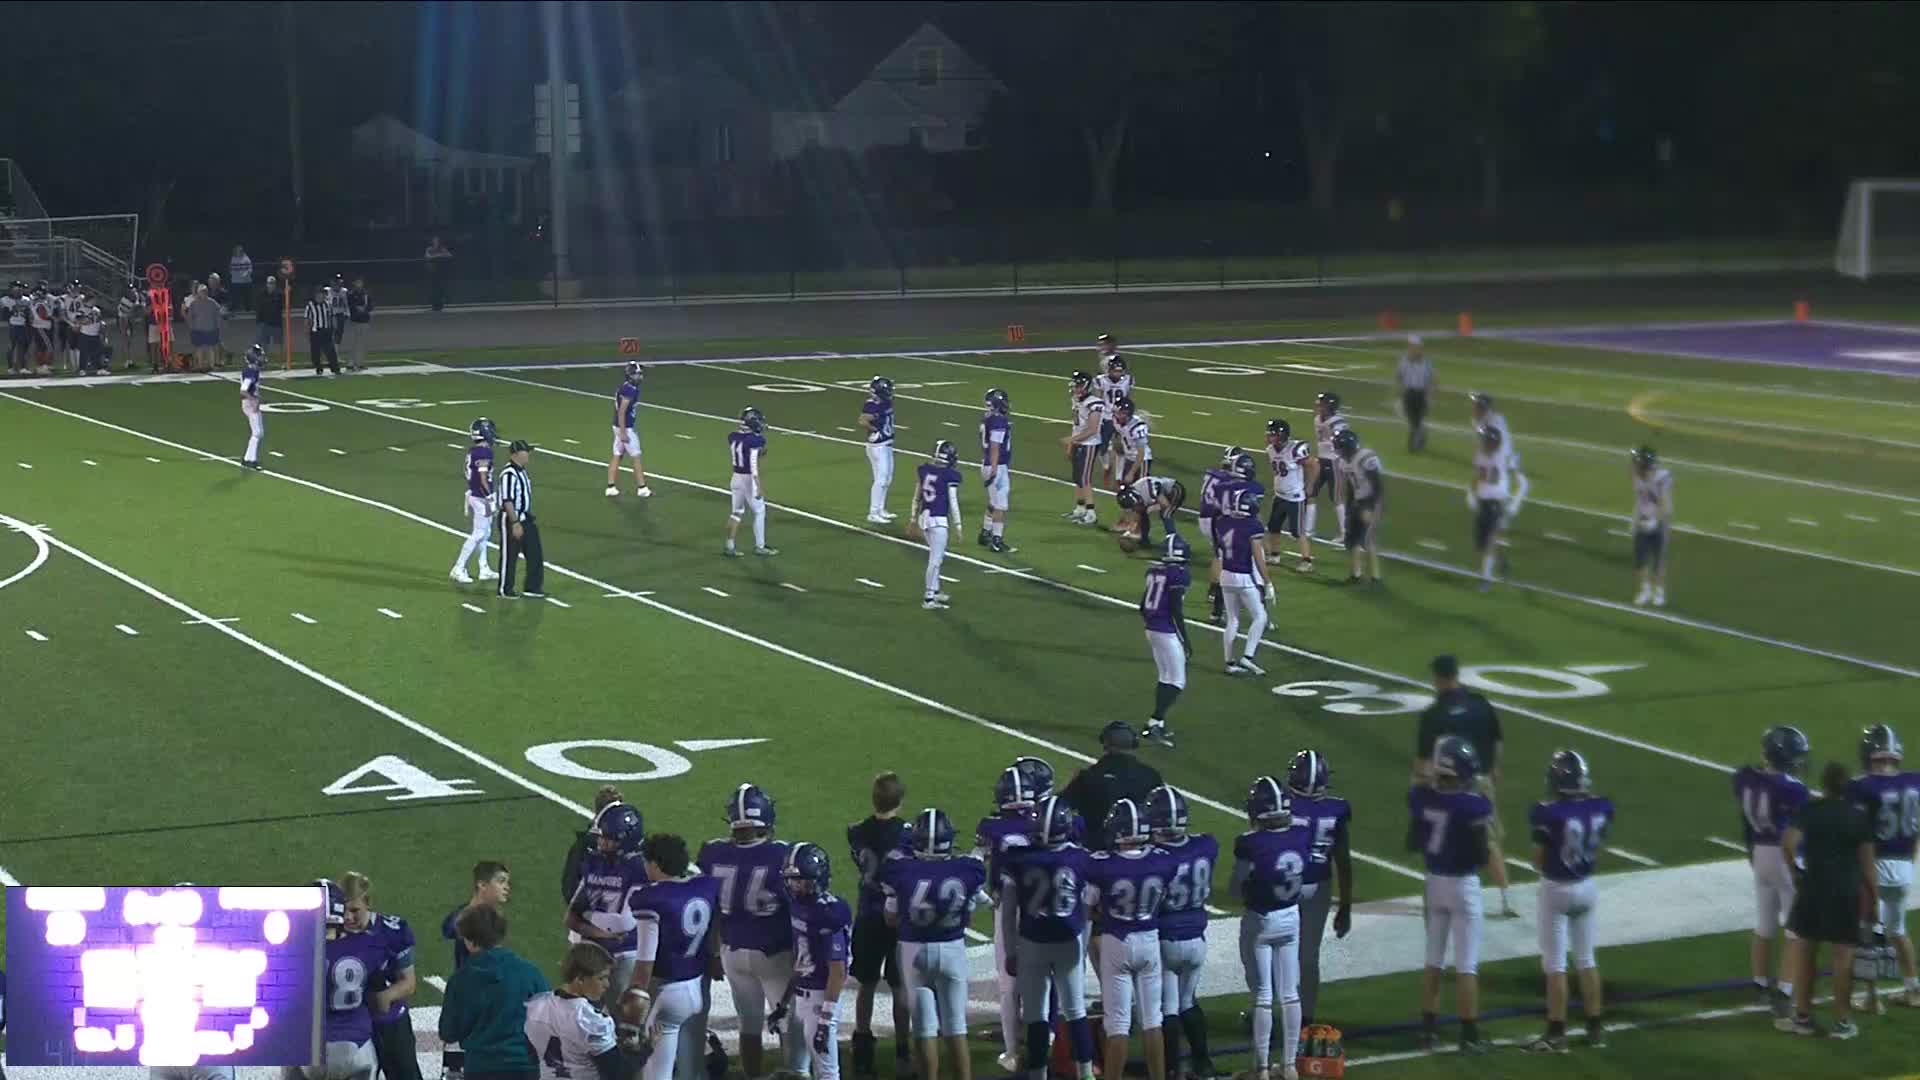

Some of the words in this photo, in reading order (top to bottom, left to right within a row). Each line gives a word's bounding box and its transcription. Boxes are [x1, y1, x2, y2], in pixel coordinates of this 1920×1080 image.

[923, 474, 938, 502] 5
[1145, 574, 1167, 610] 27
[1423, 808, 1448, 854] 7
[711, 864, 780, 917] 76
[1108, 877, 1165, 920] 30
[1274, 850, 1304, 900] 3
[909, 878, 968, 927] 62
[681, 897, 711, 958] 9
[326, 956, 367, 1011] 8
[542, 1036, 572, 1078] 4
